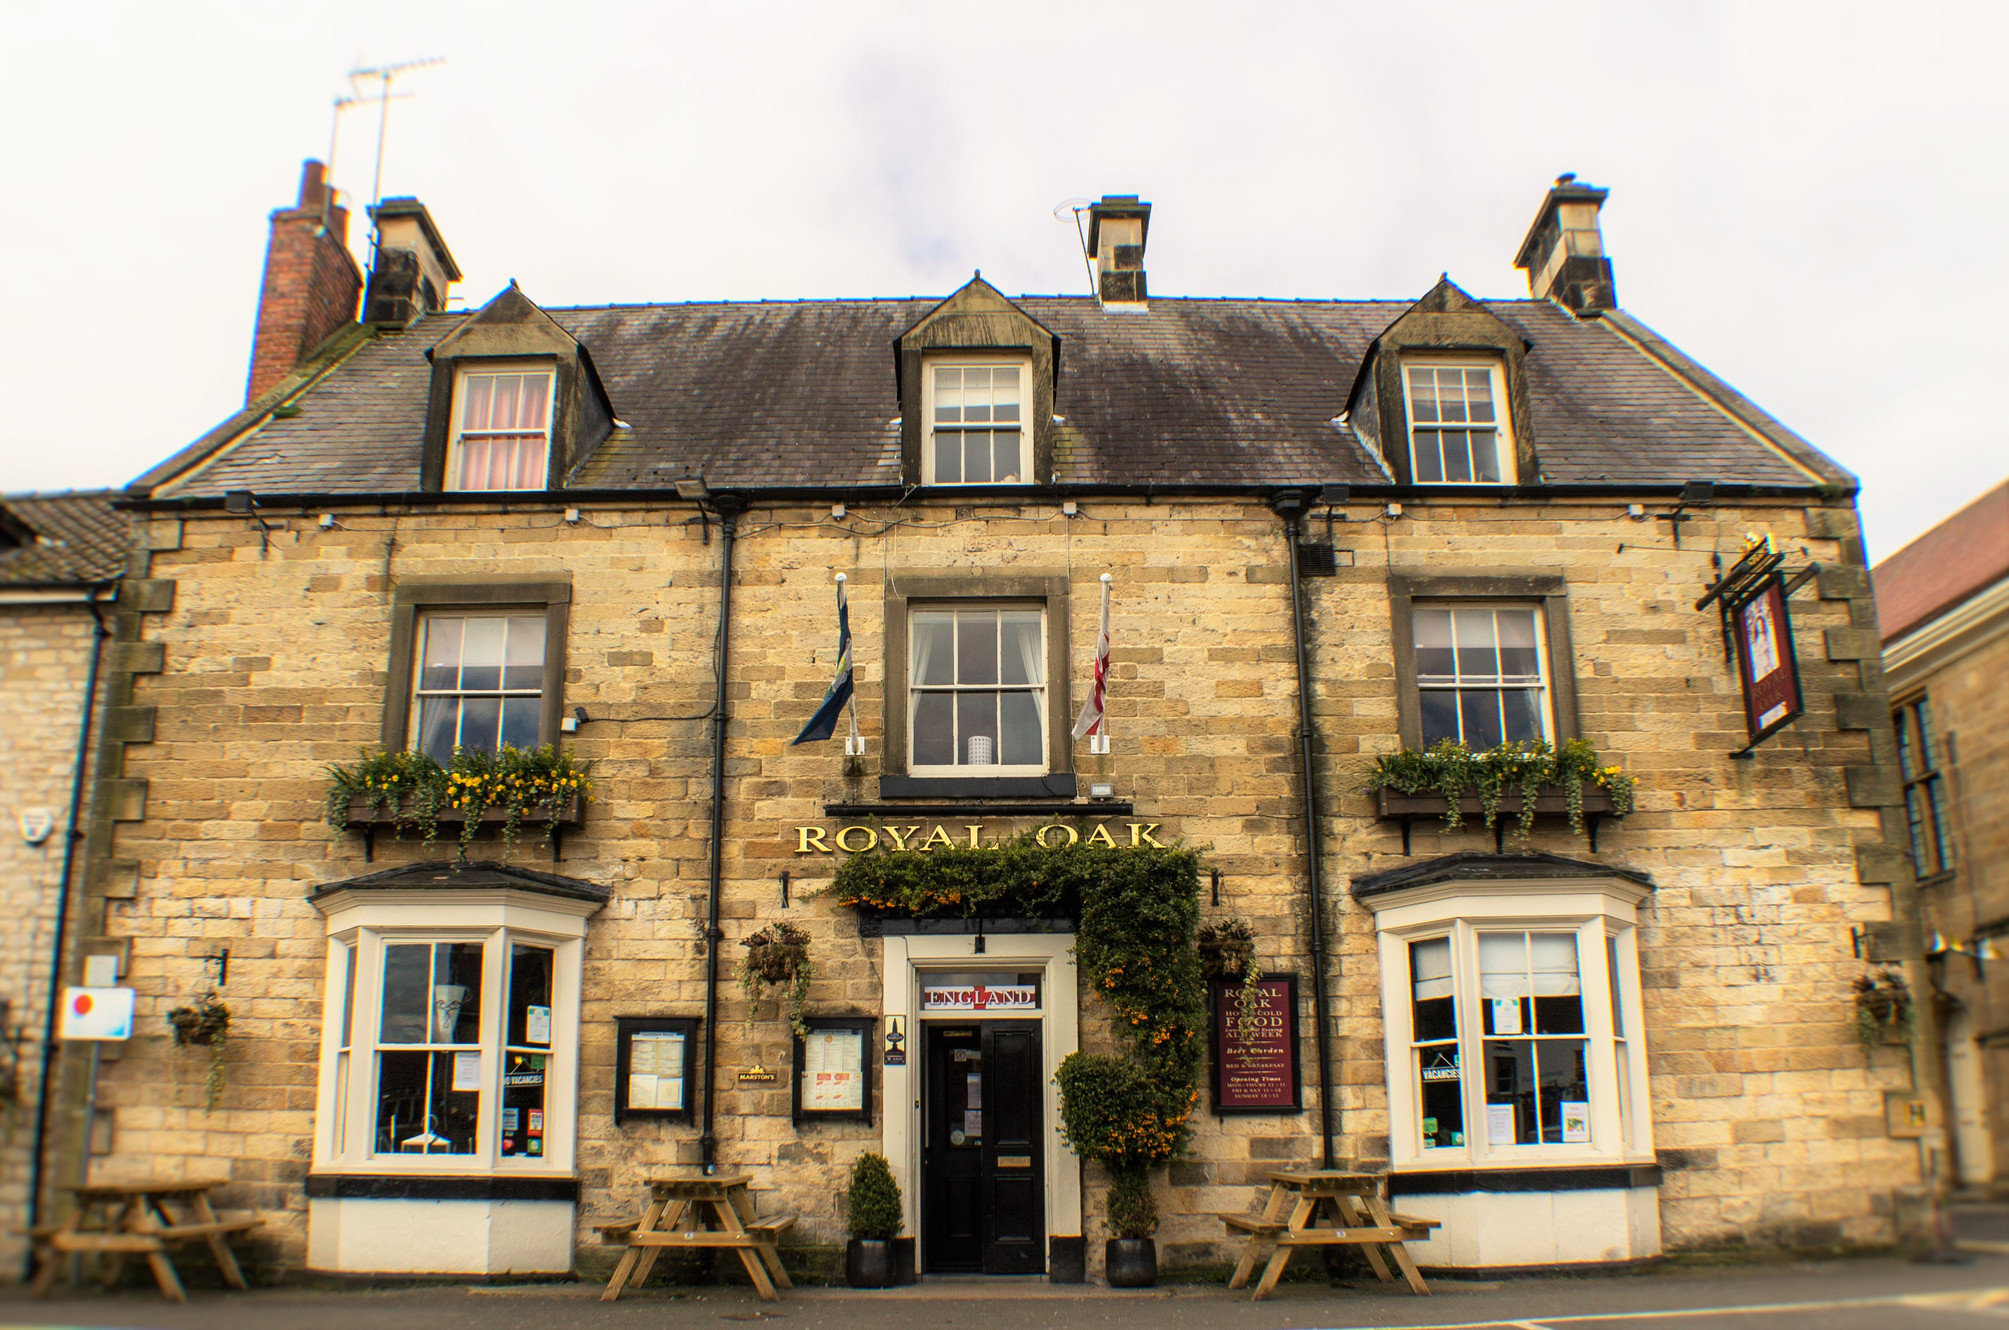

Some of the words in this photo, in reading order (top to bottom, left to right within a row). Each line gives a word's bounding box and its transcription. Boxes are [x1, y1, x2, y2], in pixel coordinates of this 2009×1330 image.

[1751, 668, 1788, 698] ROYAL
[1759, 689, 1784, 711] OAK
[794, 824, 999, 853] ROYAL
[1035, 823, 1168, 849] OAK
[930, 990, 1031, 1005] ENGLAND
[511, 1074, 543, 1085] VACANCIES
